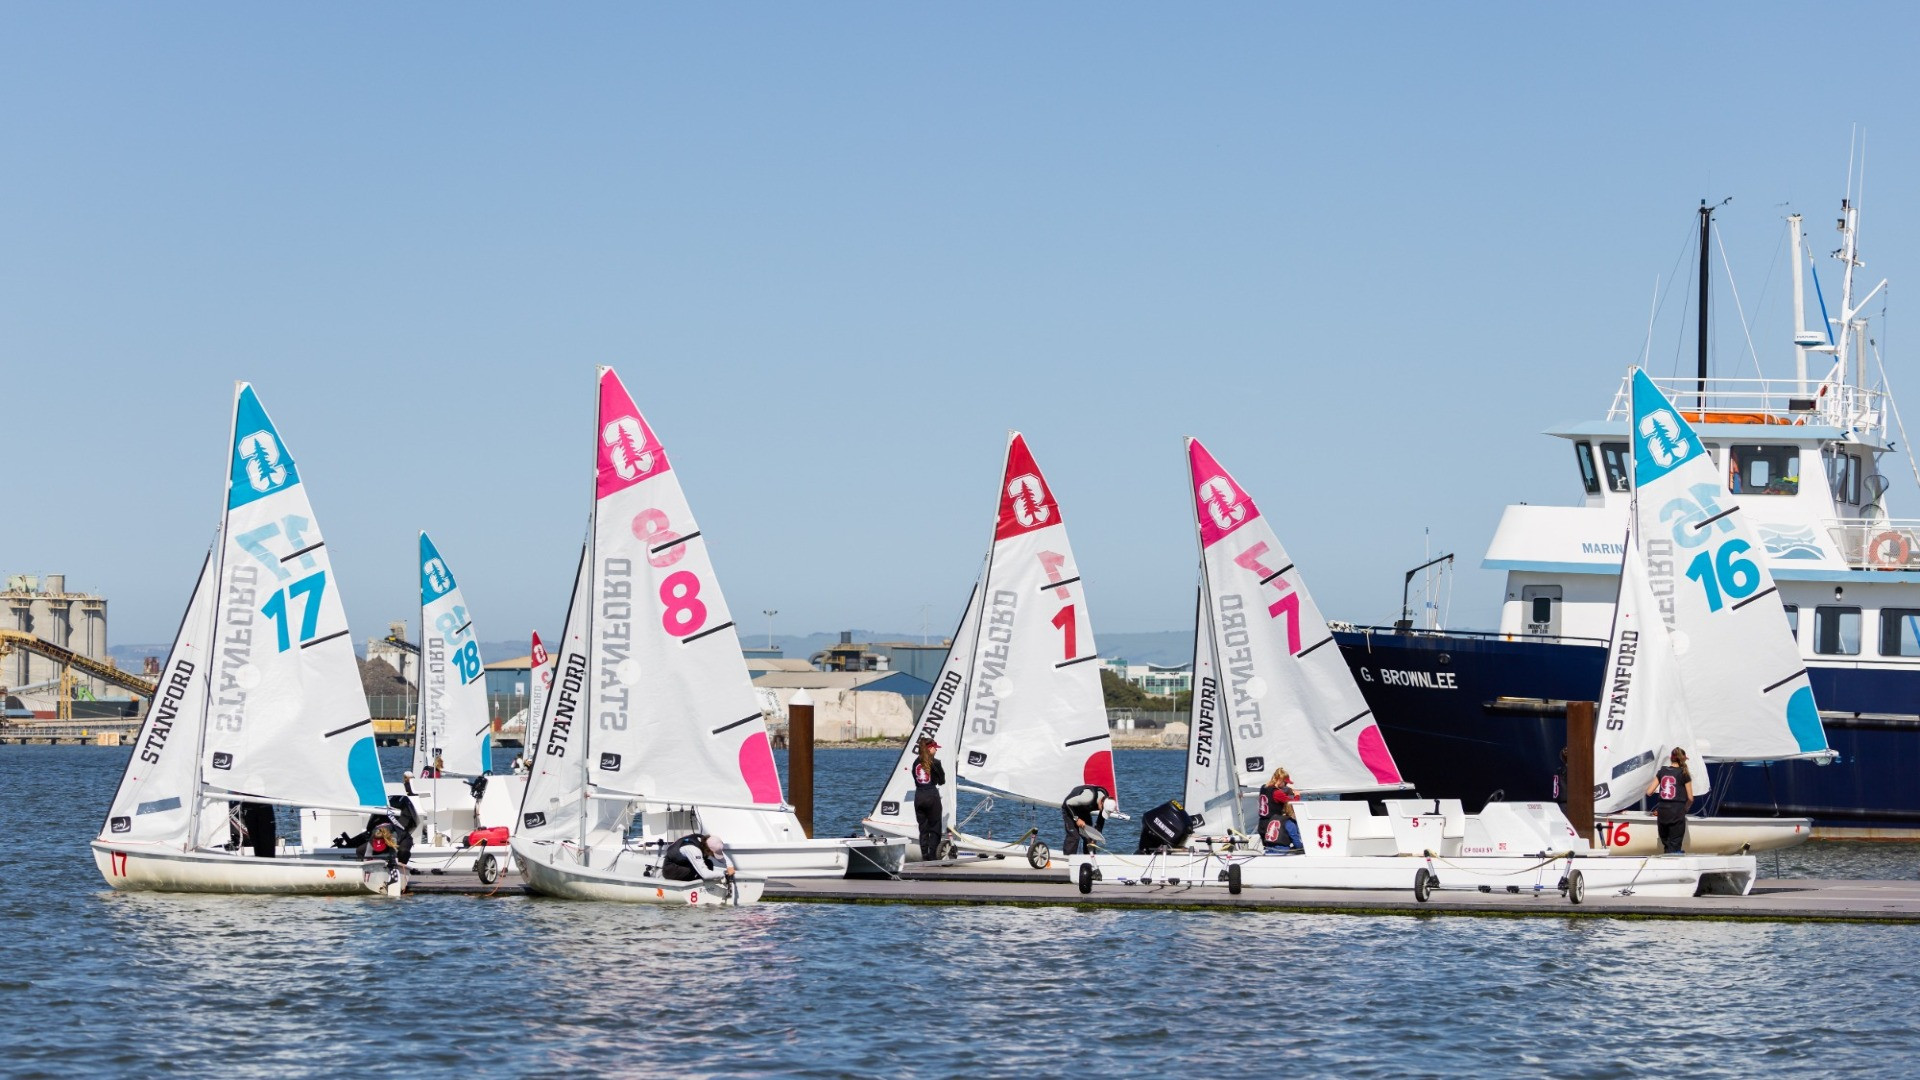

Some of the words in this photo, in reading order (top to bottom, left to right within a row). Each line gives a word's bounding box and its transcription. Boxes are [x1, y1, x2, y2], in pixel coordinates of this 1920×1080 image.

[1685, 538, 1761, 613] 16
[261, 570, 326, 653] 17
[659, 570, 708, 637] 8
[1268, 591, 1302, 656] 7
[1051, 604, 1077, 660] 1
[452, 640, 480, 685] 18
[1360, 667, 1374, 682] G.
[1380, 668, 1458, 690] BROWNLEE
[1606, 630, 1639, 731] STANFORD
[141, 659, 195, 765] STANFORD
[547, 653, 586, 758] STANFORD
[1196, 677, 1217, 767] STANFORD
[1659, 775, 1677, 800] S
[1153, 817, 1175, 838] STANFORD
[1318, 824, 1332, 849] S
[1412, 818, 1419, 827] 5
[1605, 821, 1631, 847] 16
[111, 850, 127, 877] 17
[690, 891, 698, 903] 8
